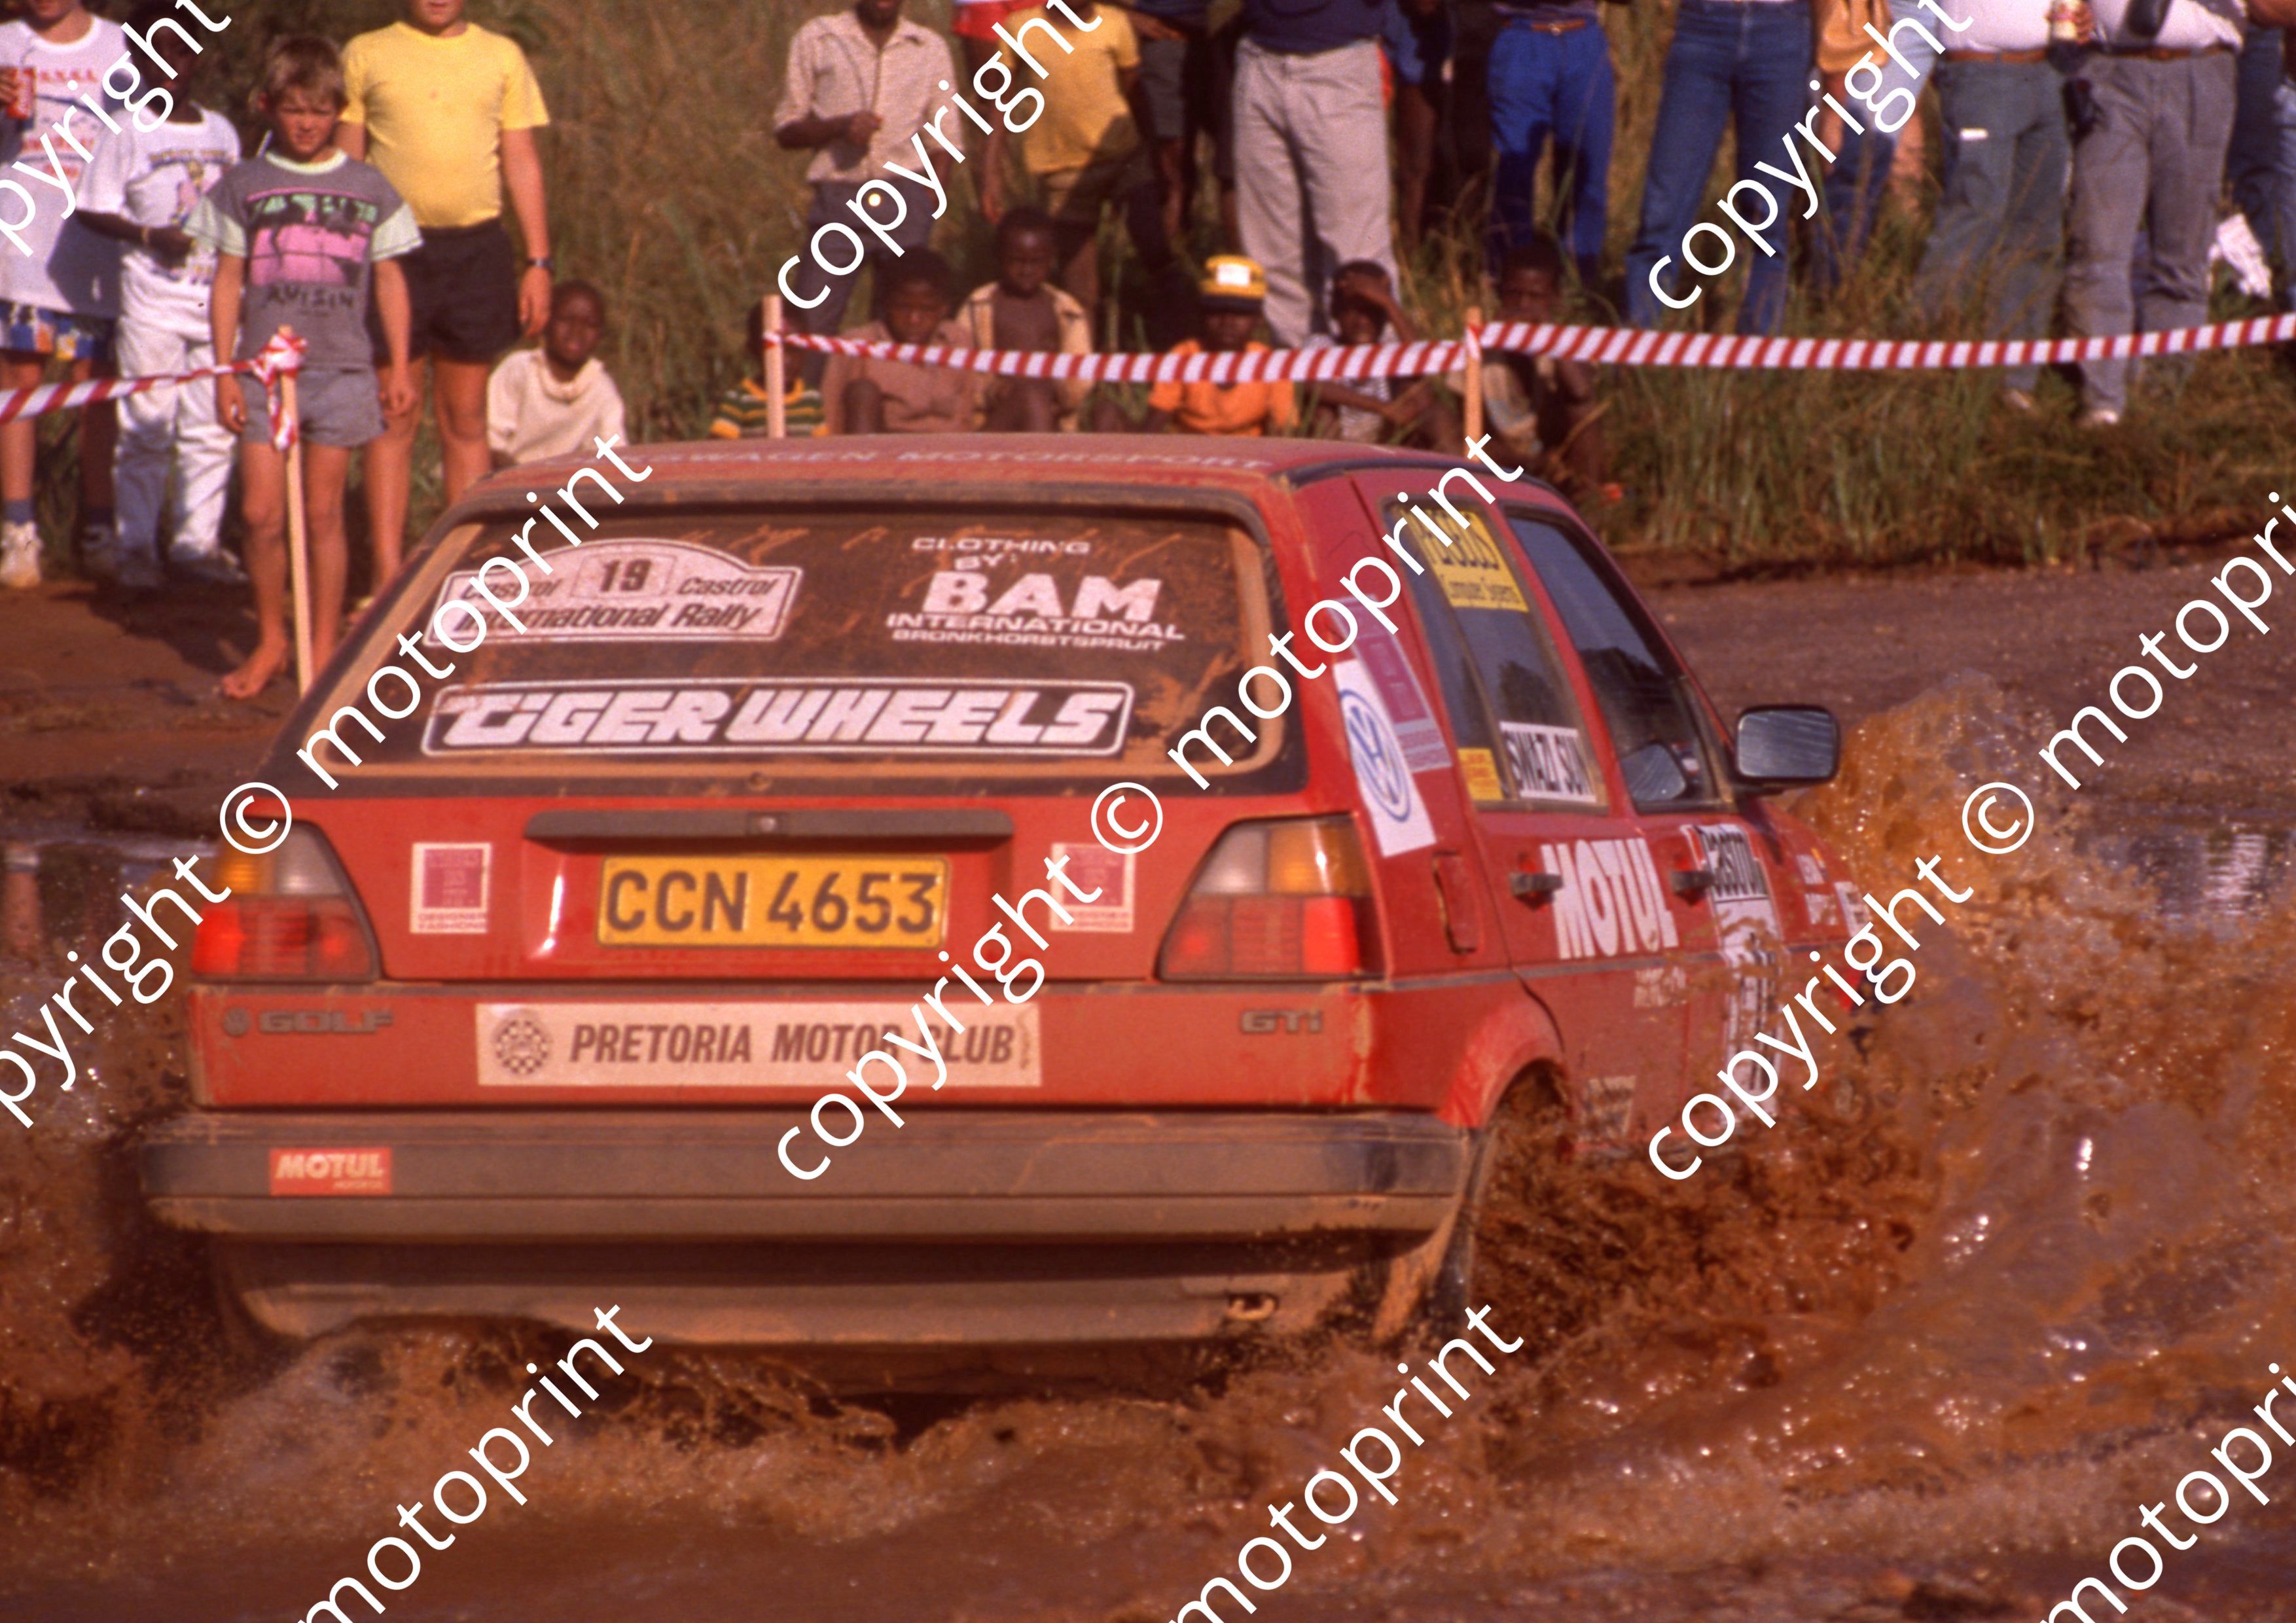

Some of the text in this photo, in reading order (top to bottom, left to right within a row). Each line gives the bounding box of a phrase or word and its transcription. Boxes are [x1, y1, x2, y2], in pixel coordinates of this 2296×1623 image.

[912, 537, 1090, 554] CLOTHING
[600, 558, 652, 592] 19
[678, 577, 778, 596] Castrol
[922, 571, 1162, 622] BAM
[671, 603, 762, 631] Rally
[886, 613, 1185, 641] INTERNATIONAL
[725, 689, 1124, 745] WHEELS
[605, 869, 940, 933] CCN 4653
[1541, 838, 1679, 960] MOTUL
[259, 1010, 394, 1034] GOLF
[570, 1024, 1014, 1065] PRETORIA MOTOR CLUB
[275, 1153, 384, 1179] MOTUL
